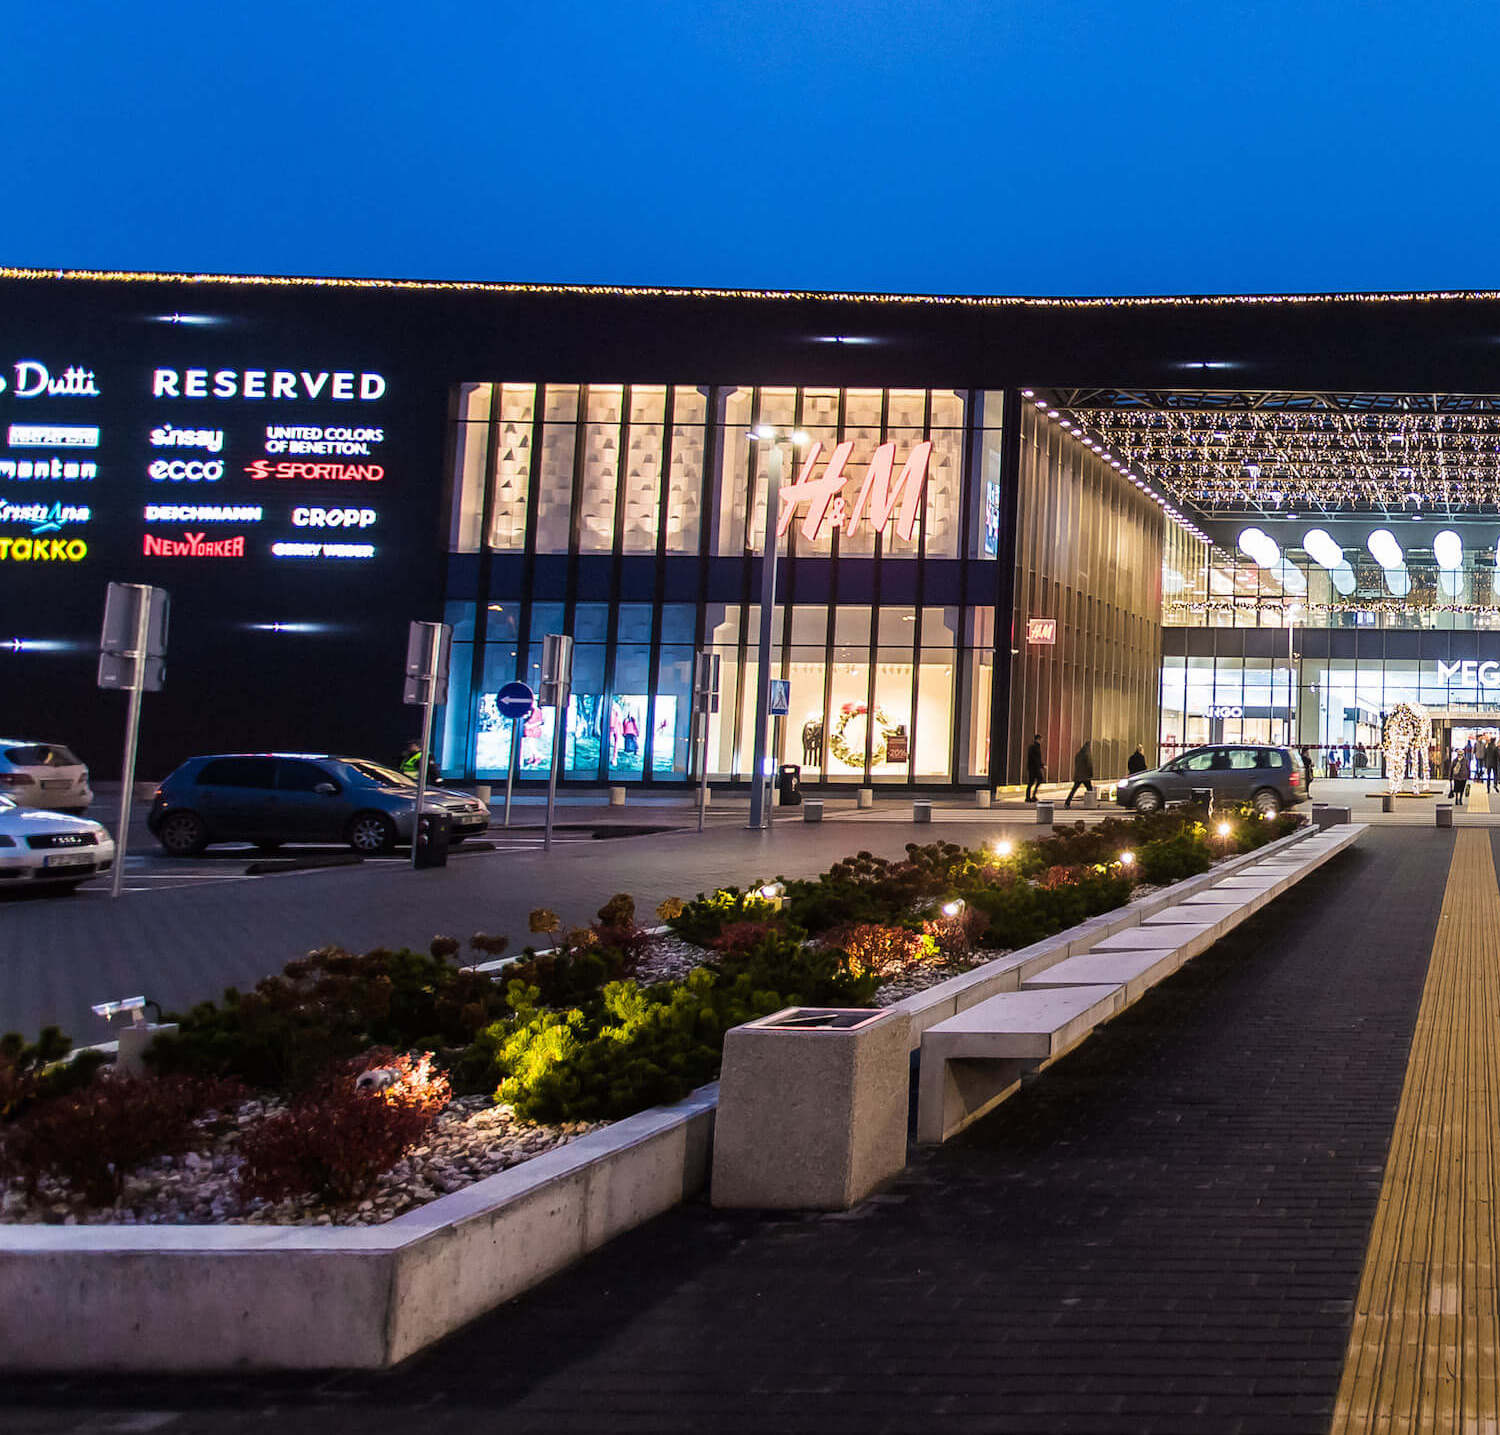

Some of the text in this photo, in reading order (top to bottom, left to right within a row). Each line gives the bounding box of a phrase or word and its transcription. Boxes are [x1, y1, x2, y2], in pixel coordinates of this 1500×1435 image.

[14, 360, 101, 398] Dutti
[153, 369, 386, 400] RESERVED
[149, 423, 225, 453] sinsay
[266, 426, 385, 442] UNITED COLORS
[265, 440, 288, 453] OF
[148, 459, 224, 481] ecco
[275, 461, 385, 481] SPORTLAND
[776, 441, 932, 542] H&M
[144, 505, 264, 522] DEICHMANN
[292, 507, 377, 528] CROPP
